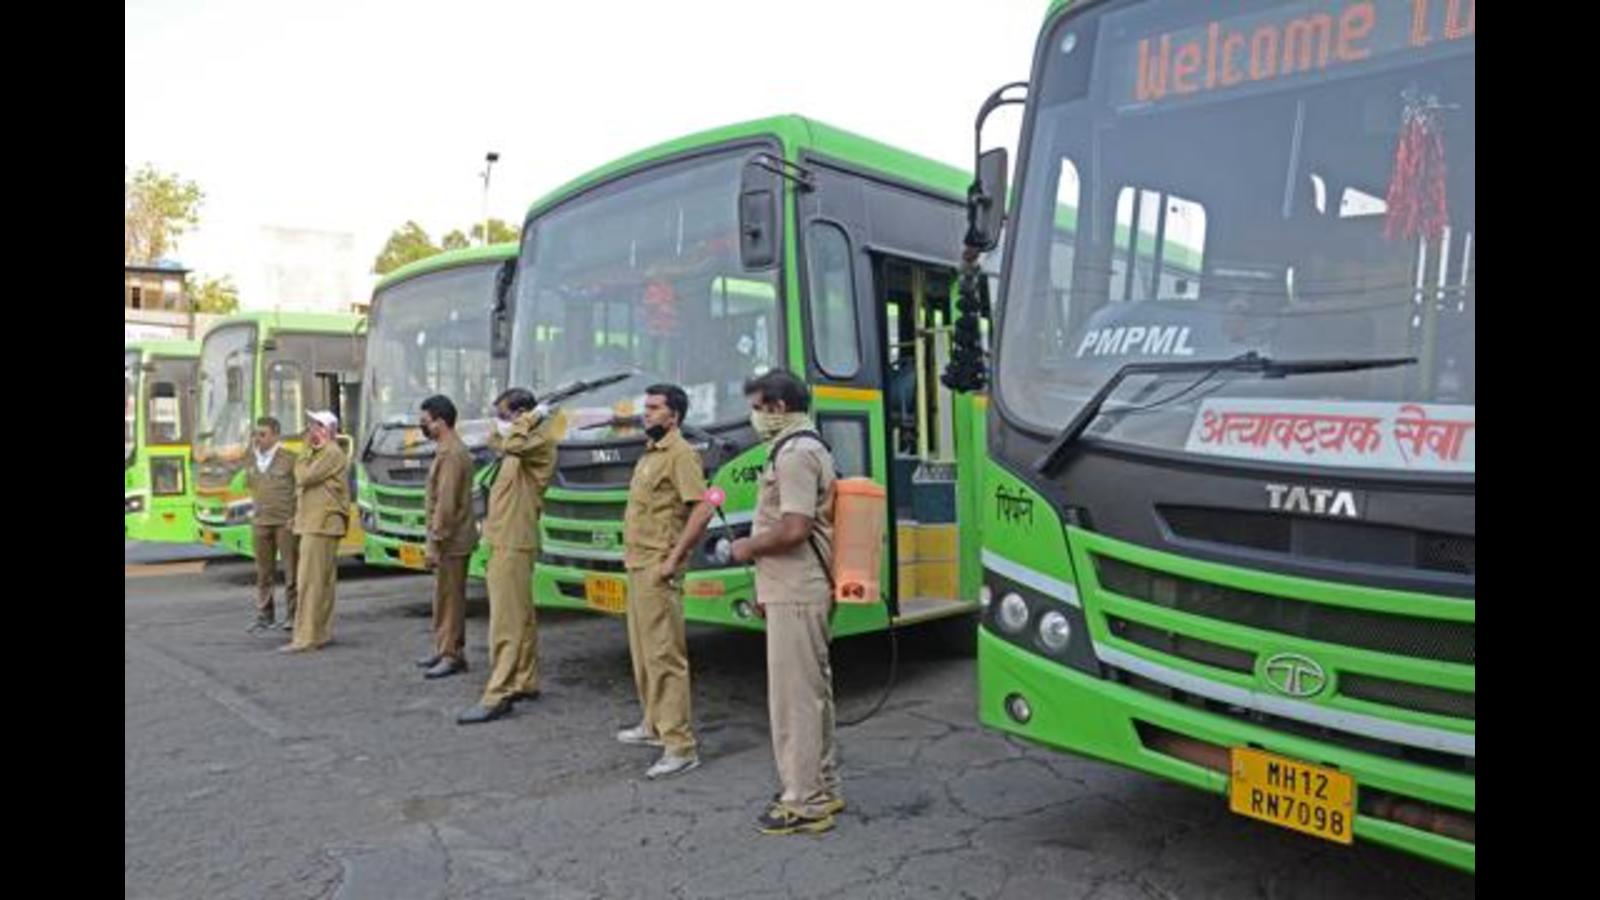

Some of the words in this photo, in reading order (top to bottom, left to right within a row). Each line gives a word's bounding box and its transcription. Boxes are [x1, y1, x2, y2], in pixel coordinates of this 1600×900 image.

[1135, 1, 1377, 101] Welcome
[1076, 326, 1195, 357] PMPML
[1265, 484, 1357, 517] TATA
[1266, 762, 1328, 800] MH12
[1251, 789, 1344, 836] RN7098
